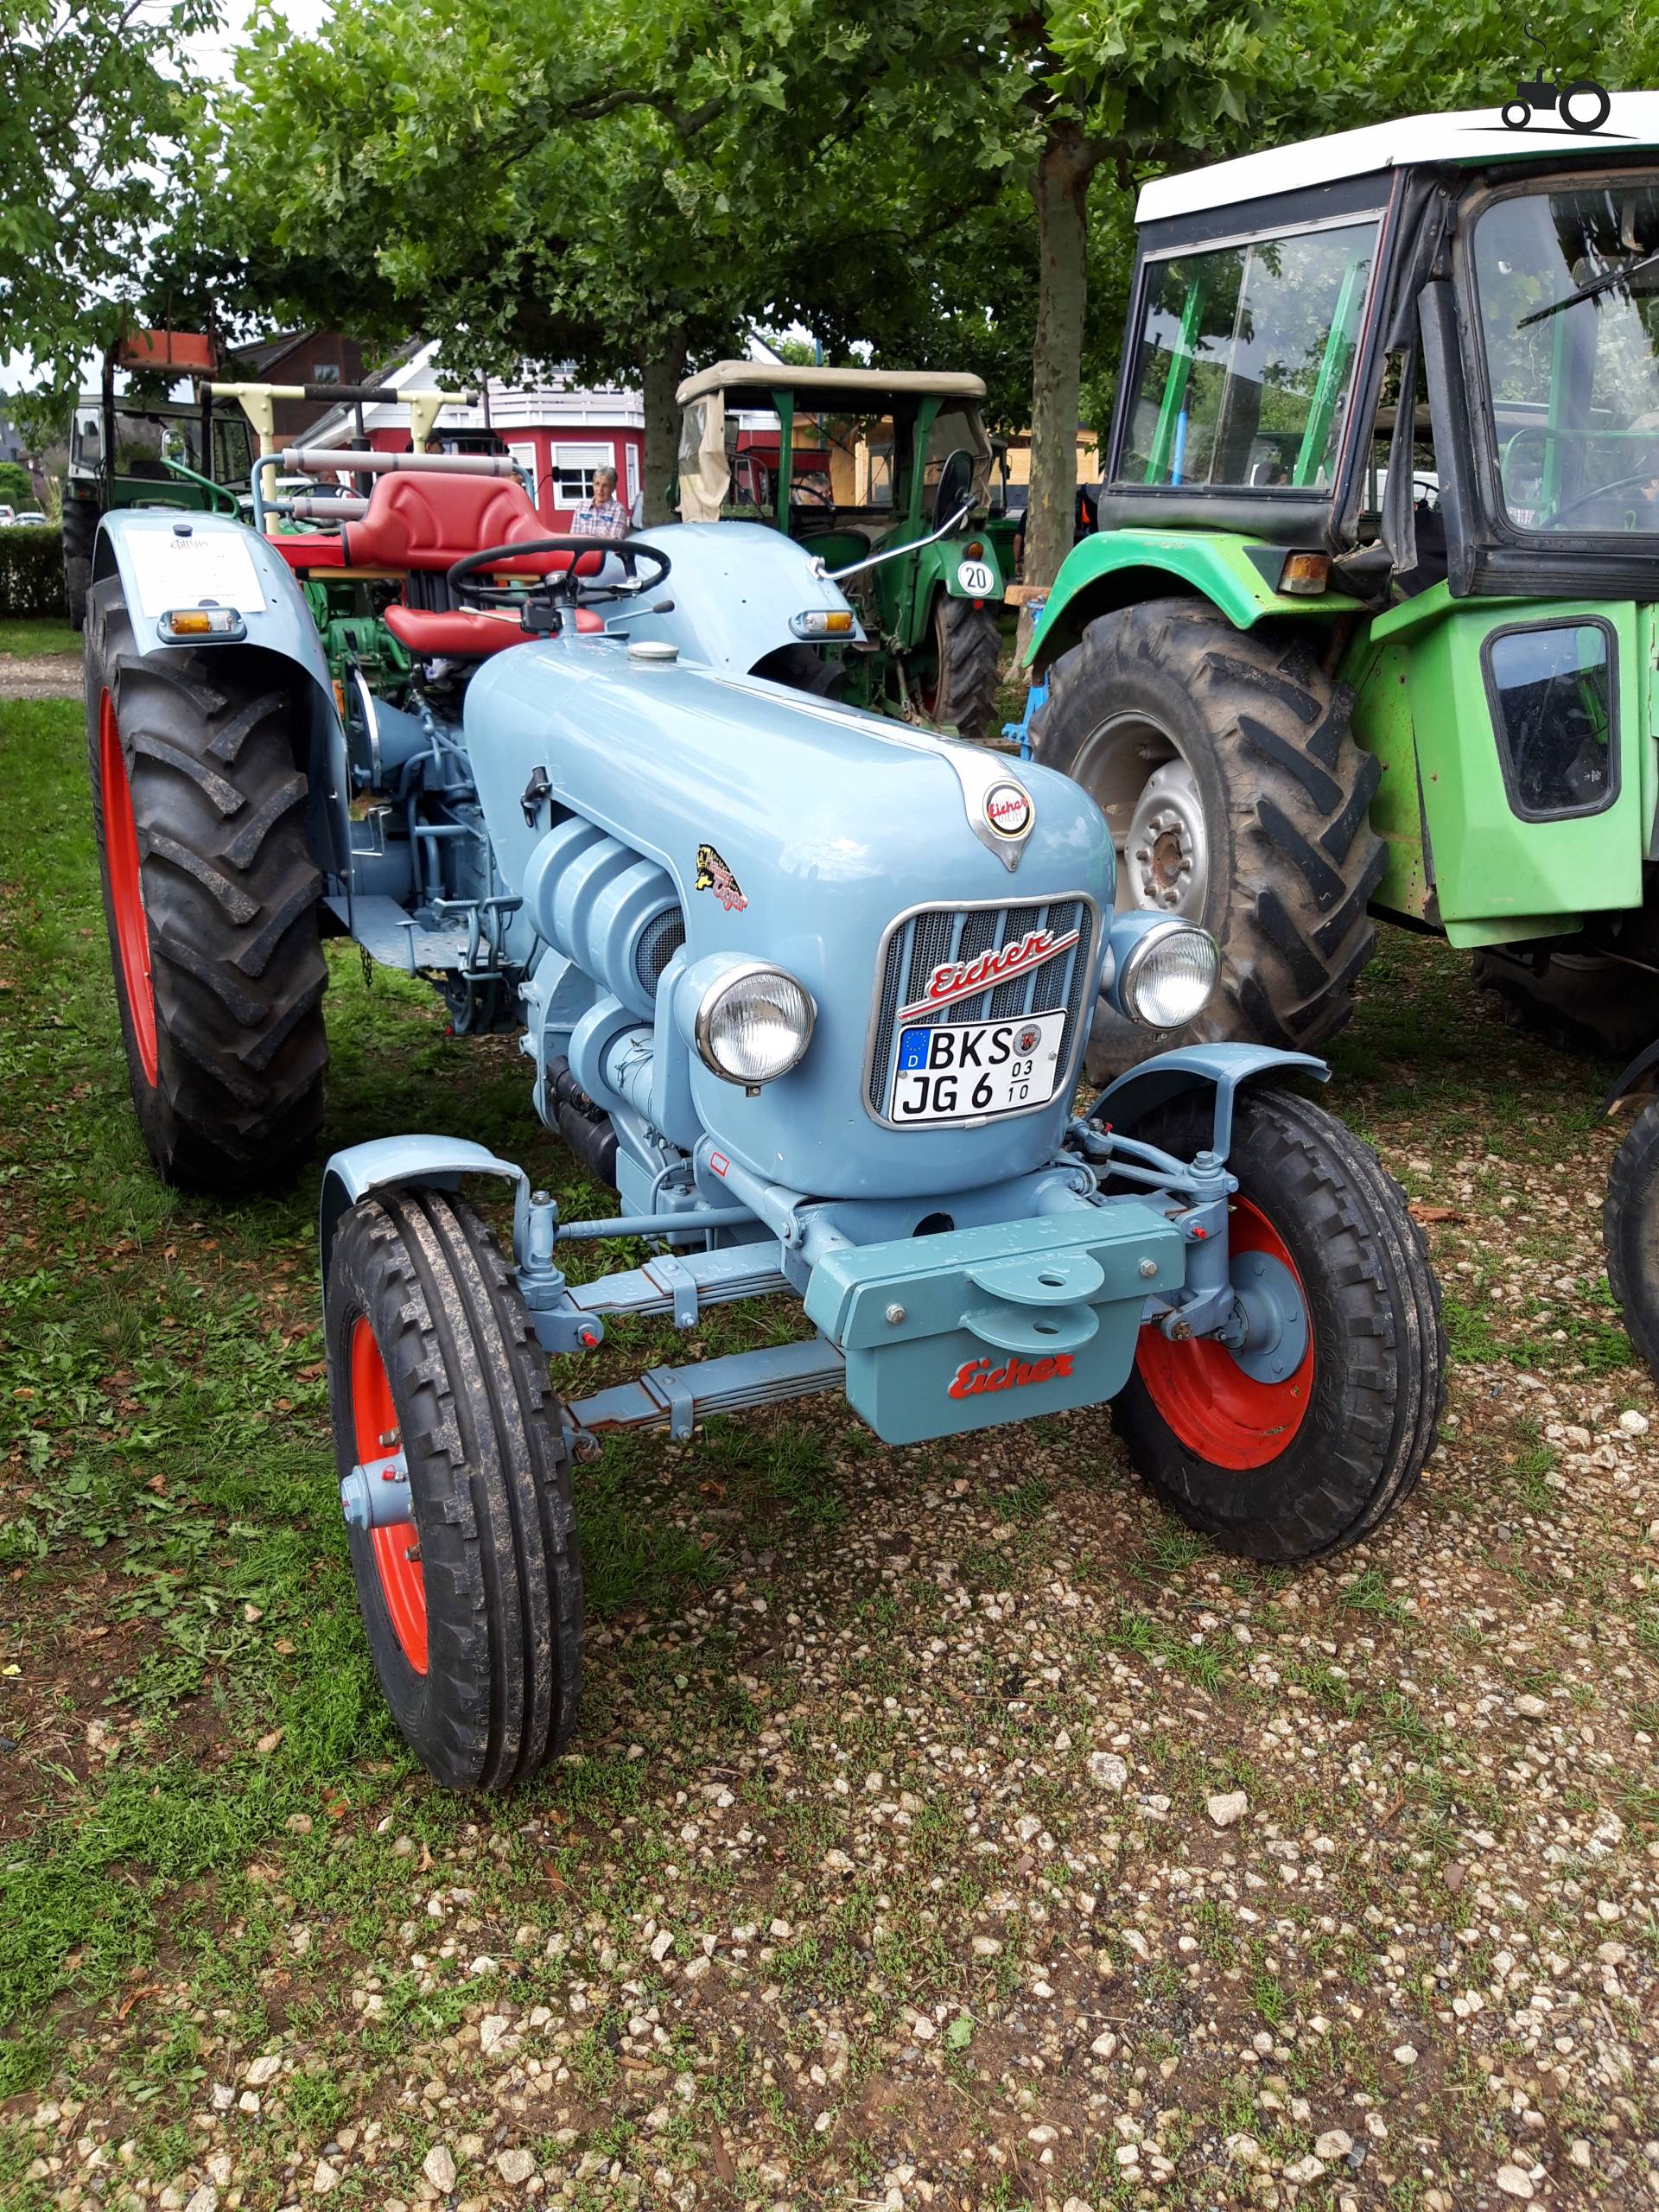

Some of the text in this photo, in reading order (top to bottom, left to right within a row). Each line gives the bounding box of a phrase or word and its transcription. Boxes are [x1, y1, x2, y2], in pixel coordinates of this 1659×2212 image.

[965, 567, 987, 589] 20
[988, 797, 1028, 819] Eicher
[926, 930, 1053, 999] Eicher
[929, 1027, 1013, 1070] BKS
[907, 1055, 919, 1068] D
[1012, 1059, 1033, 1077] 03
[903, 1072, 993, 1115] JG 6
[1007, 1084, 1029, 1103] 10
[947, 1353, 1074, 1400] Eicher
